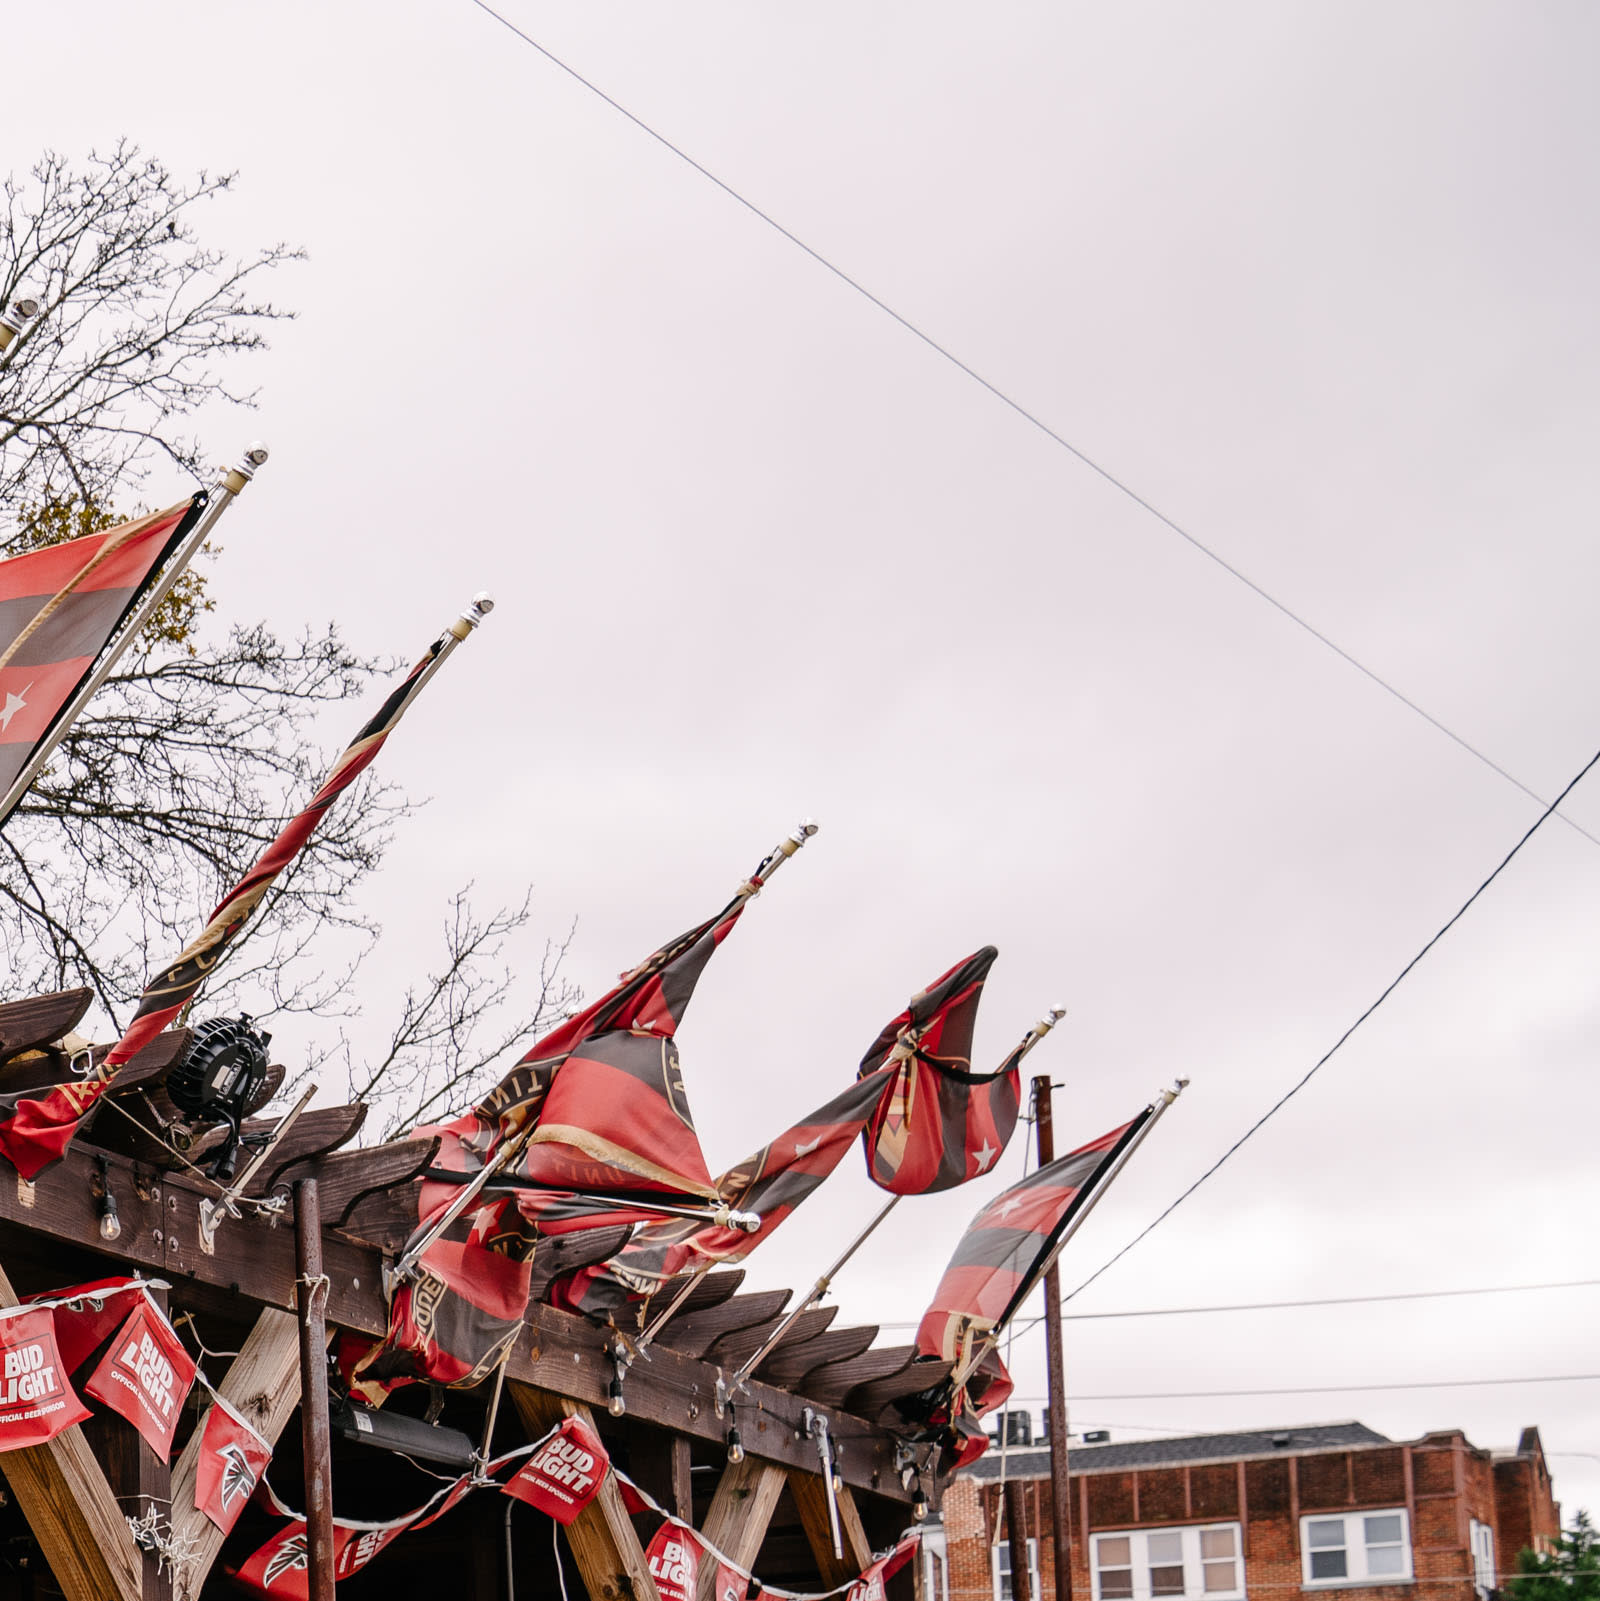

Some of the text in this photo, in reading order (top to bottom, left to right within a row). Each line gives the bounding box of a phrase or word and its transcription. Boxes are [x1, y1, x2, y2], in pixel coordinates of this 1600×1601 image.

[4, 1344, 44, 1379] BUD
[139, 1331, 174, 1388] BUD
[110, 1370, 139, 1397] OFFICIAL
[120, 1341, 175, 1418] LIGHT
[24, 1408, 42, 1420] BEER
[528, 1451, 594, 1492] LIGHT
[546, 1437, 594, 1473] BUD
